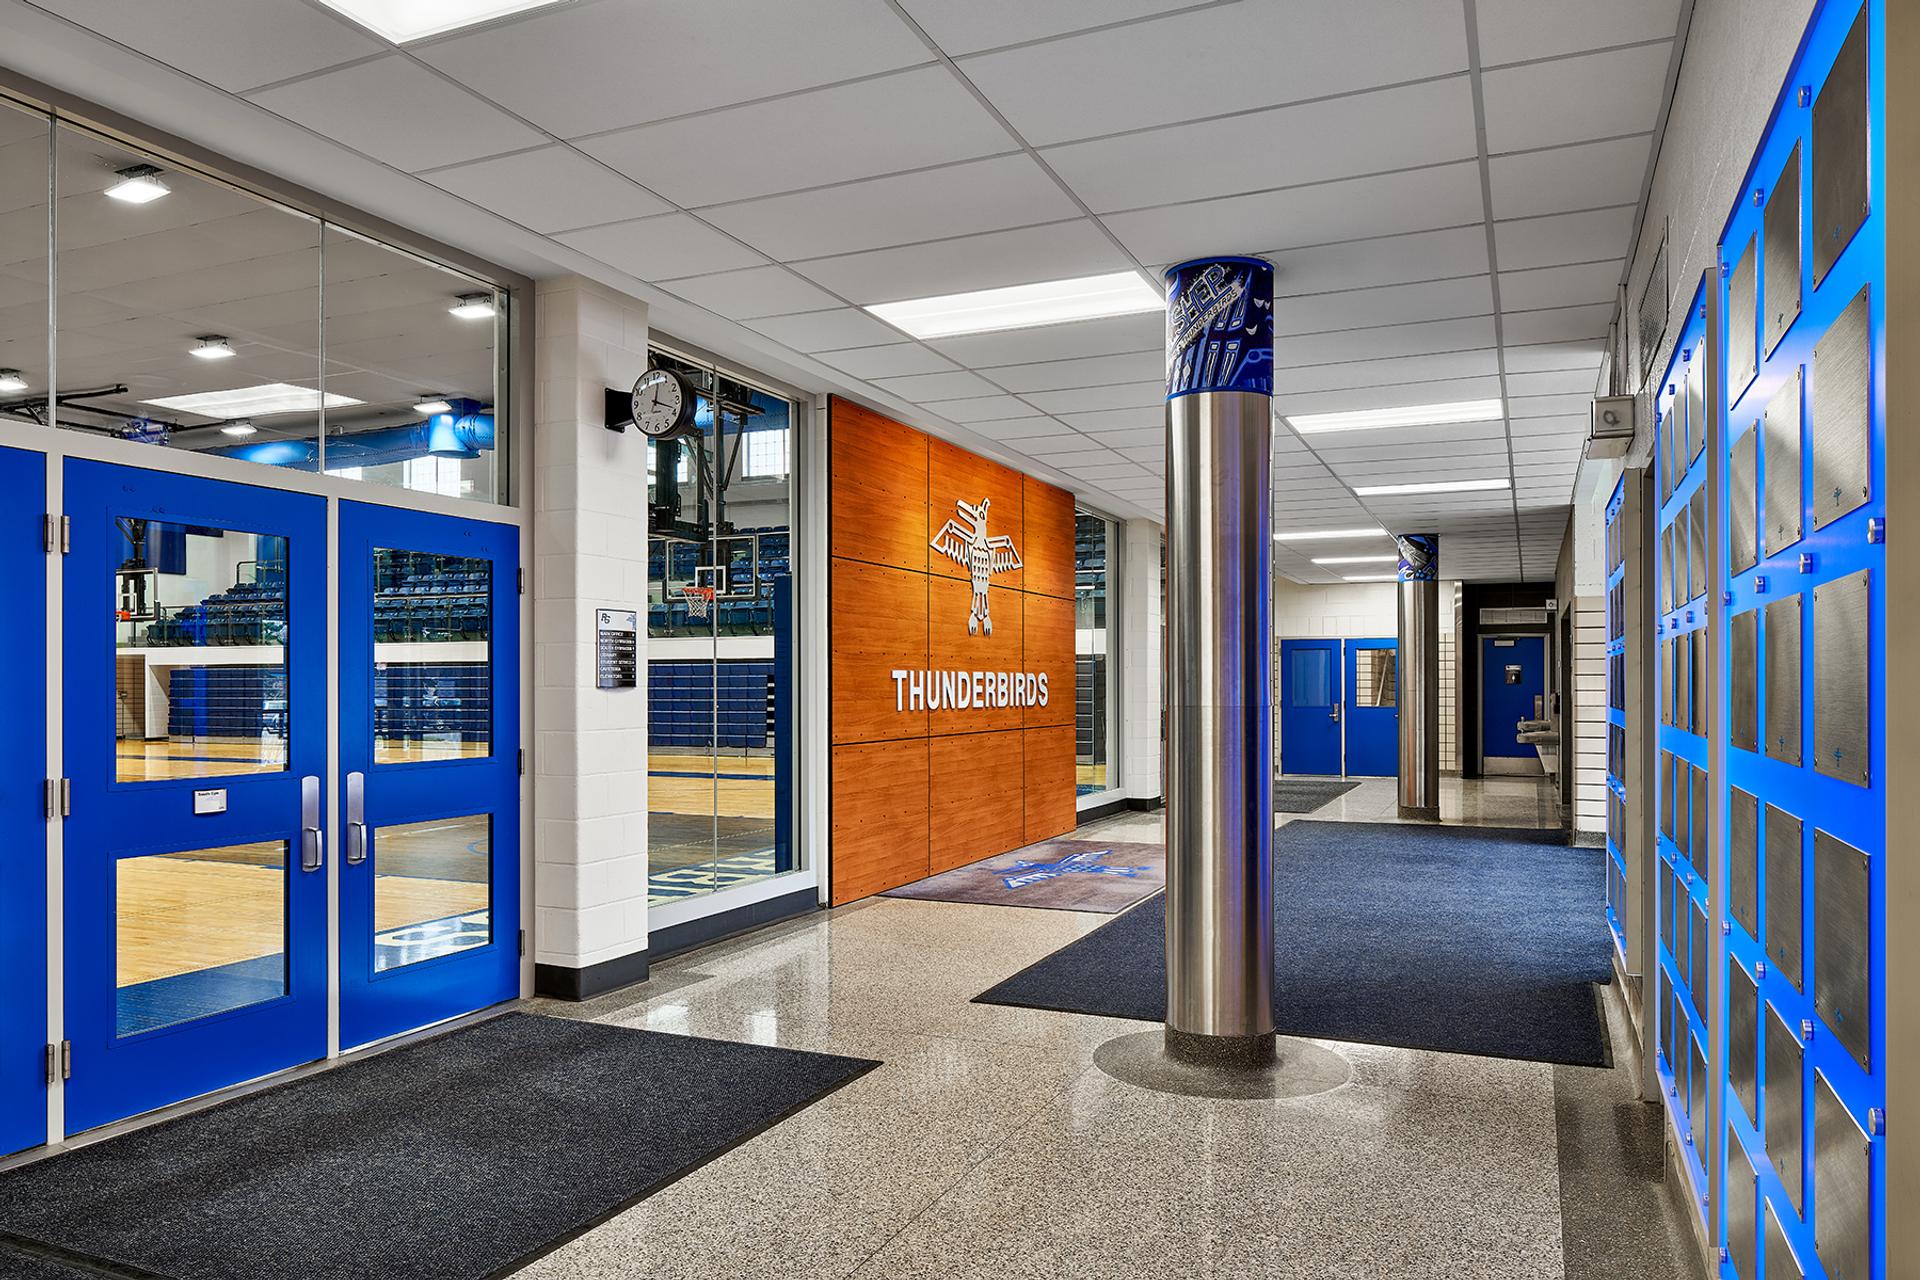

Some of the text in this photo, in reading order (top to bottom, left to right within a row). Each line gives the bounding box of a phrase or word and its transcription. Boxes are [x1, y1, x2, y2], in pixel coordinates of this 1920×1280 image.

[1172, 264, 1225, 335] SHEP
[672, 383, 677, 392] 2
[634, 400, 639, 409] 9
[675, 395, 680, 405] 3
[636, 412, 642, 421] 8
[672, 409, 677, 417] 4
[645, 421, 650, 430] 7
[655, 423, 660, 432] 6
[664, 419, 670, 428] 5
[891, 670, 1049, 712] THUNDERBIRDS
